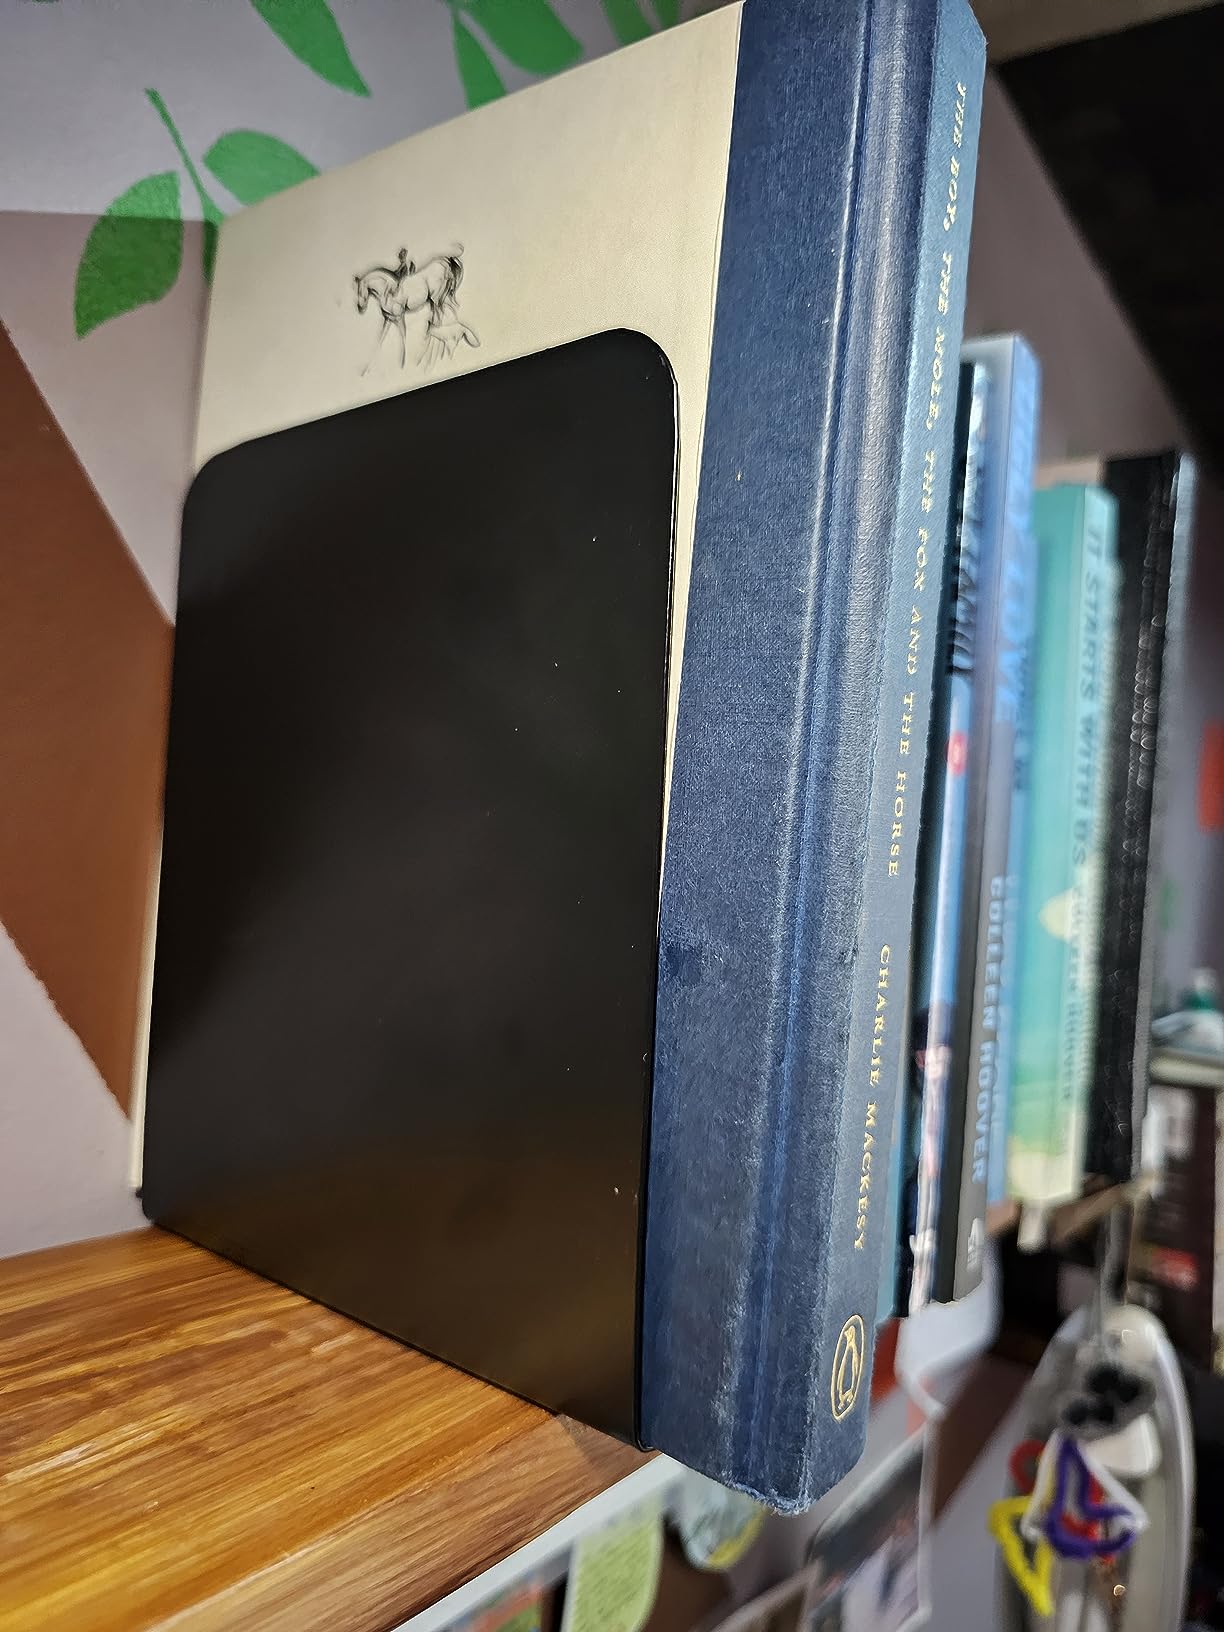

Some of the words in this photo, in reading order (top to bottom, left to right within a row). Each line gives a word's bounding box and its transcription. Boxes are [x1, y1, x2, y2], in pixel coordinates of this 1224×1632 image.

[953, 81, 967, 148] THE
[938, 251, 952, 316] THE
[922, 450, 936, 514] THE
[913, 527, 928, 592] FOX
[907, 605, 922, 676] AND
[1080, 570, 1099, 701] STARTS
[900, 692, 915, 755] THE
[1074, 715, 1095, 808] WITH
[888, 770, 907, 878] HORSE
[982, 875, 1003, 1032] COLLEEN
[868, 943, 891, 1088] CHARLIE
[971, 1040, 995, 1185] HOOVER
[853, 1101, 877, 1250] MACKESY
